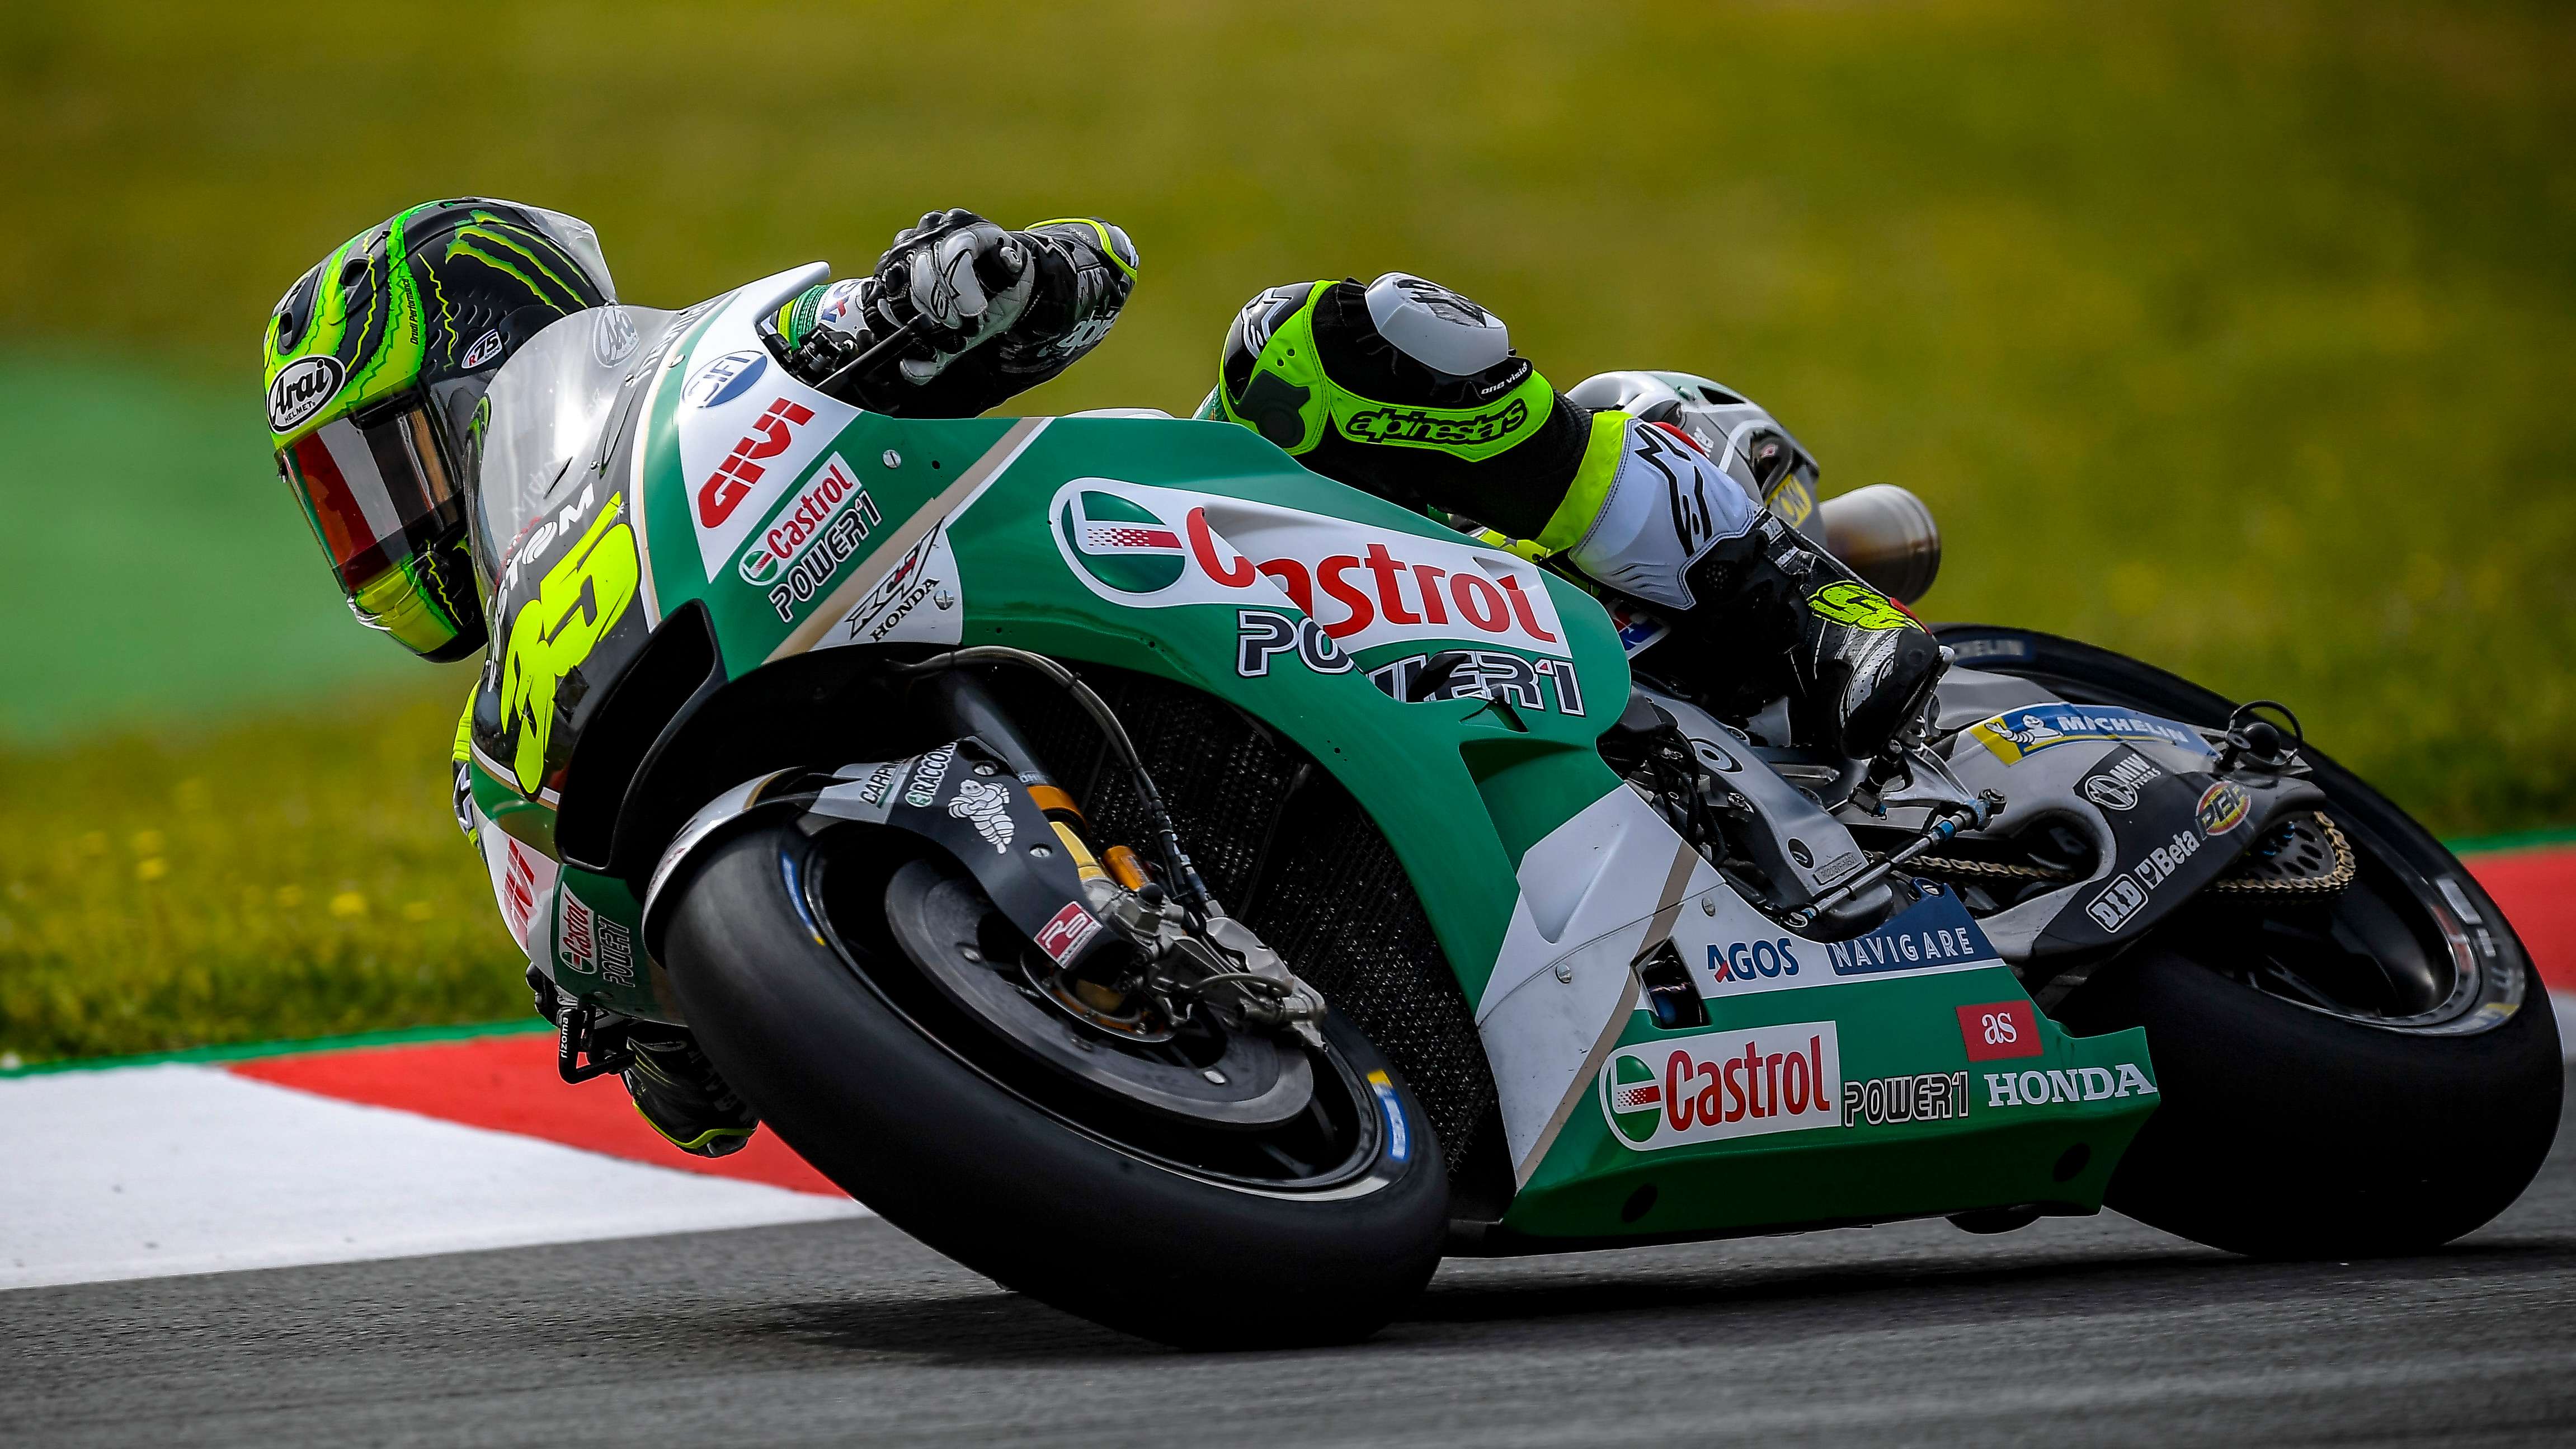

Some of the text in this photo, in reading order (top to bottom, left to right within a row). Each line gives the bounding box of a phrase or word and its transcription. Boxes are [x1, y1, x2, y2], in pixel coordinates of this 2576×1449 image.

[403, 279, 418, 345] Drudi Performance
[272, 359, 329, 425] Arai
[1481, 381, 1505, 394] one
[1346, 398, 1528, 445] alpinestars
[697, 397, 816, 529] GIVI
[766, 463, 854, 559] Castrol
[767, 488, 882, 623] POWER1
[1186, 507, 1556, 643] Castrol
[870, 577, 940, 642] HONDA
[501, 491, 638, 793] 35
[2056, 717, 2189, 742] MICHELIN
[2109, 753, 2151, 783] MIW
[2150, 830, 2200, 877] Beta
[563, 893, 592, 959] Castrol
[1832, 926, 1975, 968] NAVIGARE
[1706, 938, 1800, 982] AGOS
[1981, 1012, 2018, 1045] as
[1664, 1034, 1830, 1131] Castrol
[1844, 1070, 1969, 1129] POWER1
[1984, 1063, 2158, 1108] HONDA
